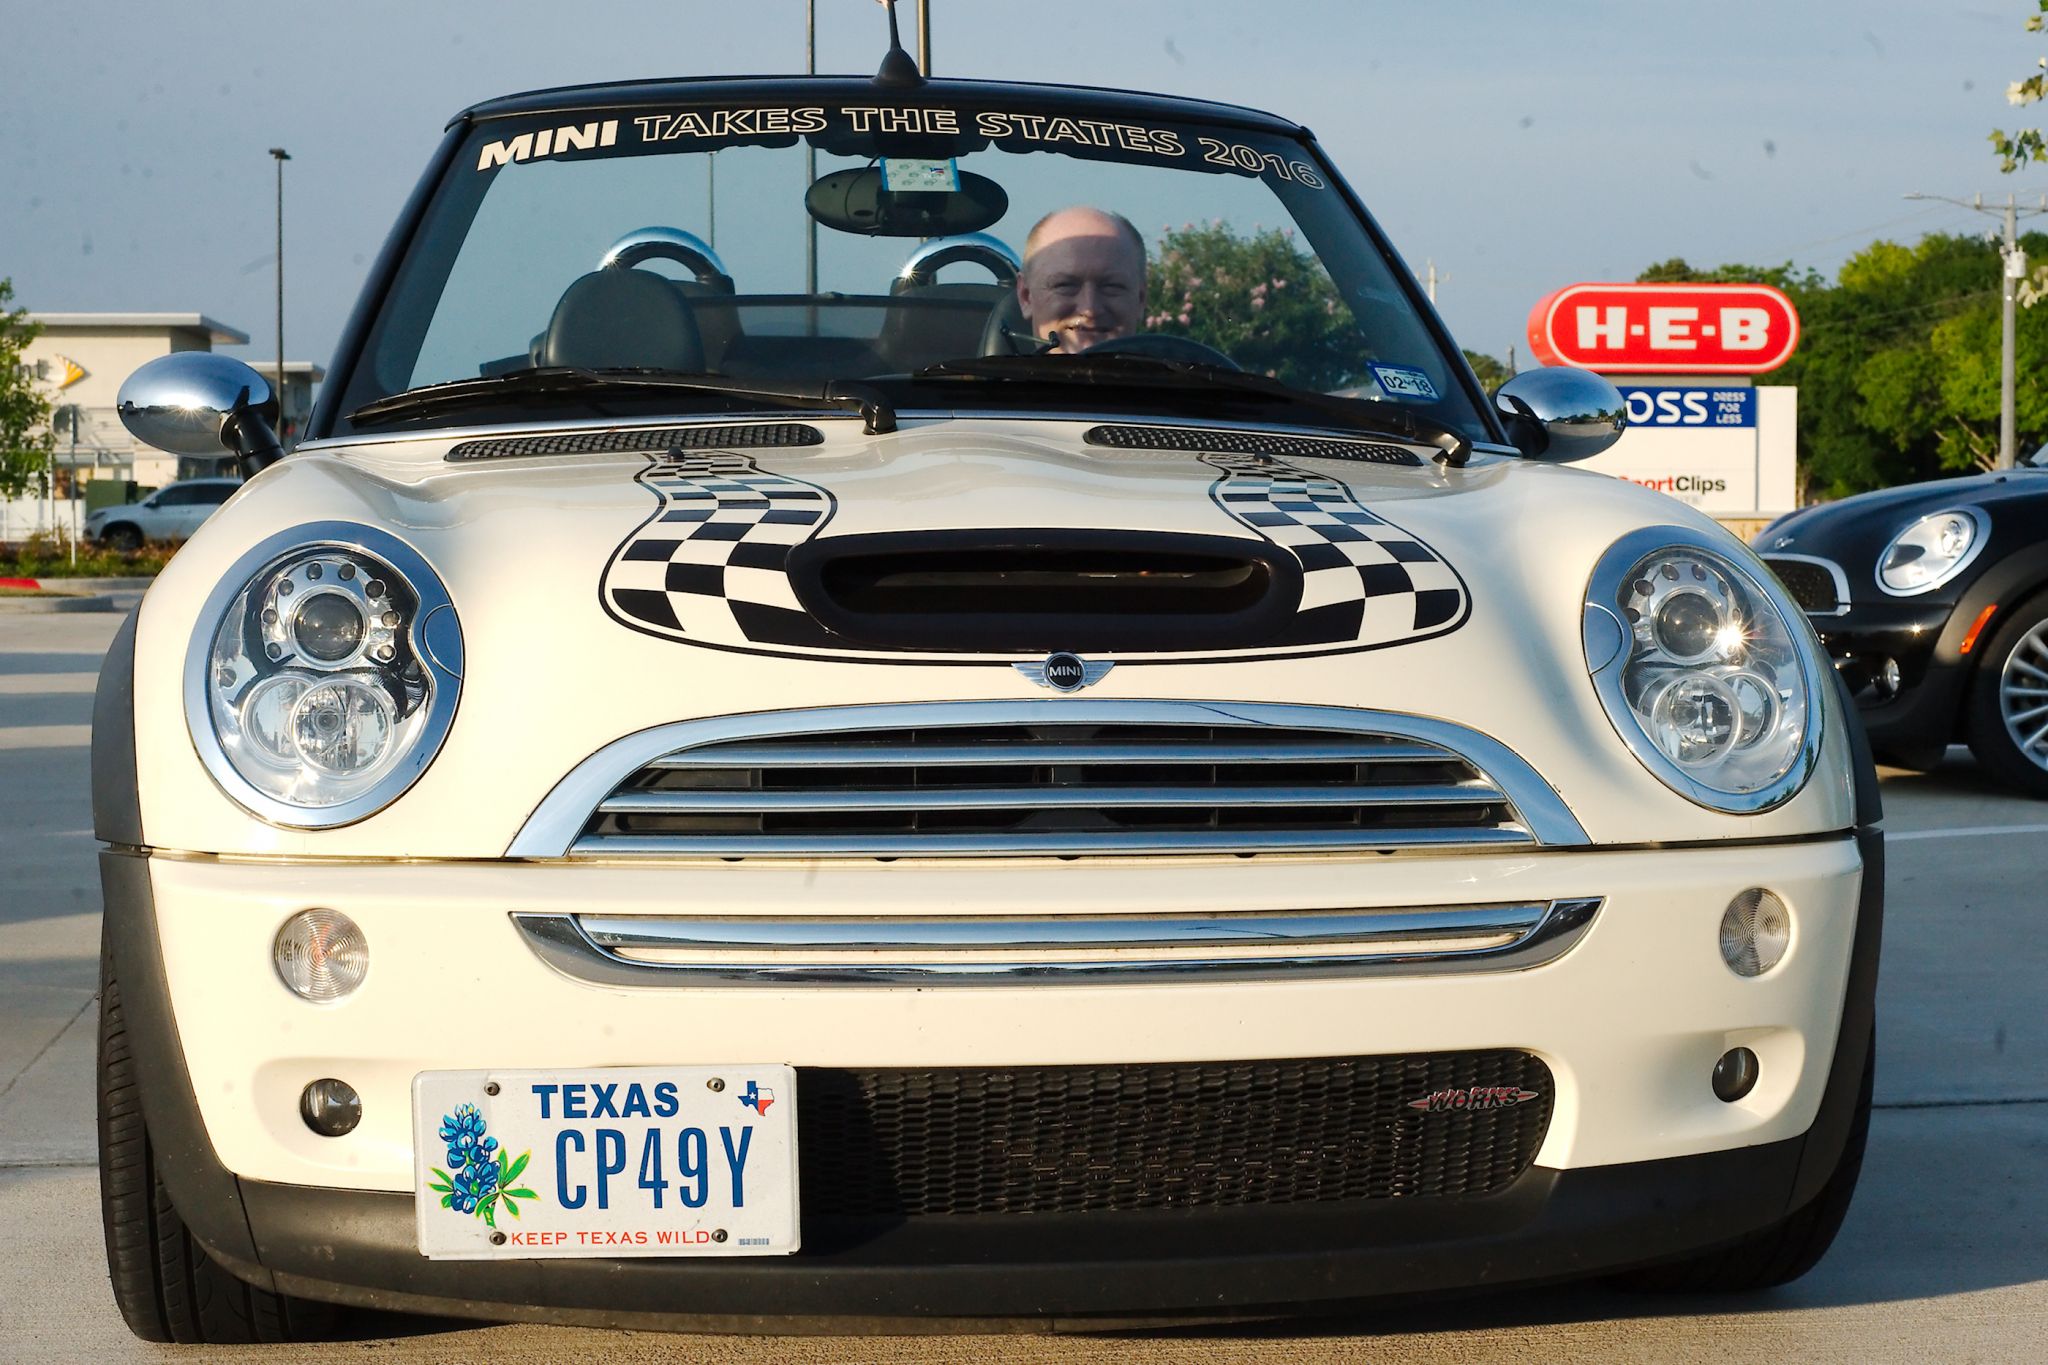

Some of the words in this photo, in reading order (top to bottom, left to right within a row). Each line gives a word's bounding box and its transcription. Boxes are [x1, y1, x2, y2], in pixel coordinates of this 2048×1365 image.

[477, 119, 619, 171] MINI
[634, 107, 828, 141] TAKES
[841, 107, 960, 136] THE
[975, 111, 1186, 157] STATES
[1199, 137, 1326, 190] 2016
[1576, 306, 1771, 350] H-E-B
[1625, 391, 1708, 424] OSS
[1712, 391, 1746, 402] DRESS
[1718, 402, 1740, 413] FOR
[1715, 413, 1742, 424] LESS
[1049, 665, 1081, 677] MINI
[531, 1082, 679, 1119] TEXAS
[1426, 1089, 1520, 1112] WORKS
[555, 1125, 754, 1210] CP49Y
[511, 1231, 568, 1246] KEEP
[577, 1231, 648, 1245] TEXAS
[656, 1230, 710, 1245] WILD
